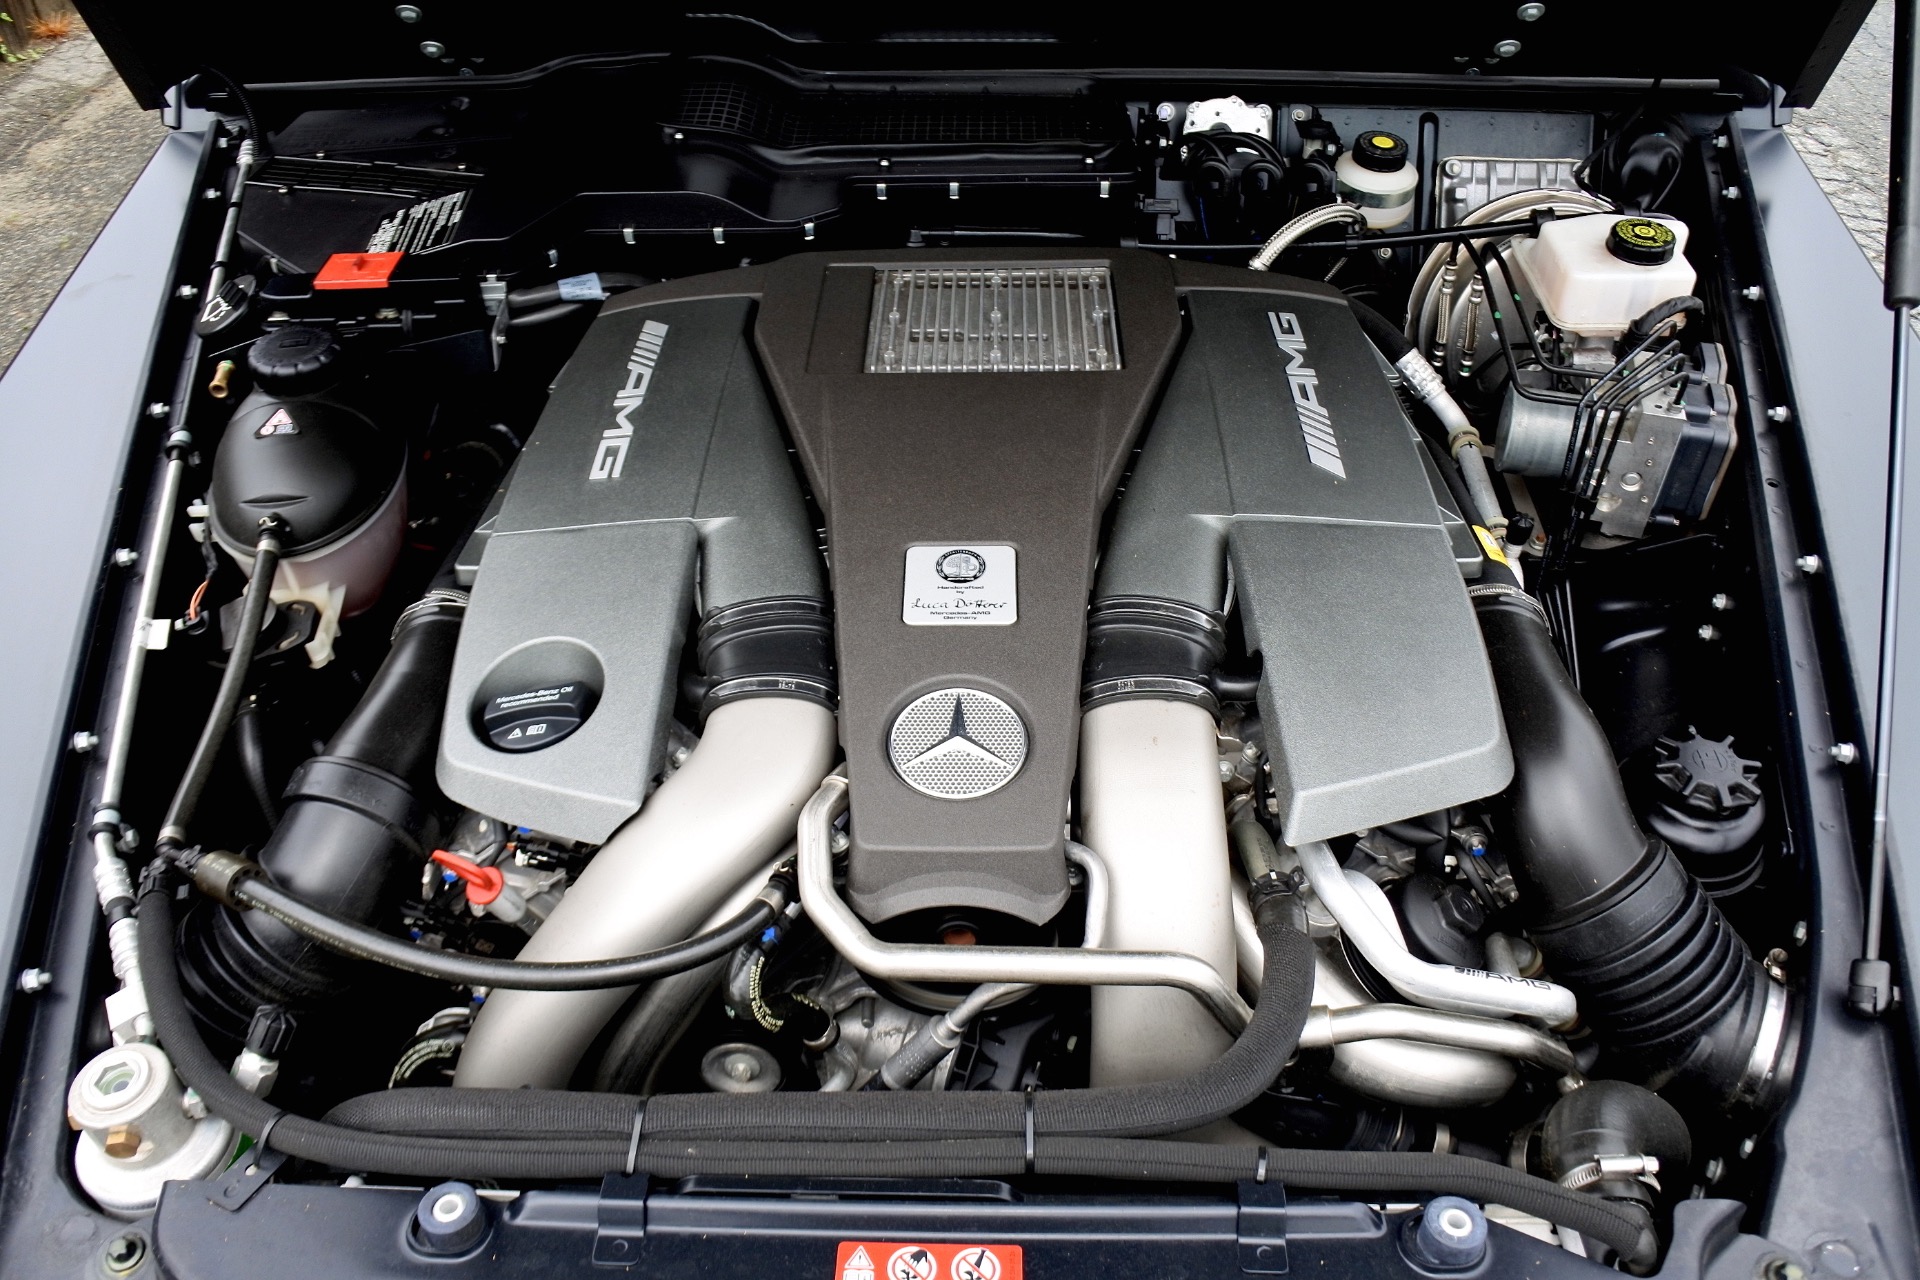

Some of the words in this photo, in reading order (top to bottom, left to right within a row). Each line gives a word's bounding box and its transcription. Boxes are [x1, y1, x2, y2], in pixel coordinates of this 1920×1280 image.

[1267, 312, 1330, 418] AMG
[588, 360, 654, 480] AMG
[495, 688, 560, 704] Mercedes-Benz
[500, 694, 560, 708] recommended
[1485, 971, 1552, 991] AMG
